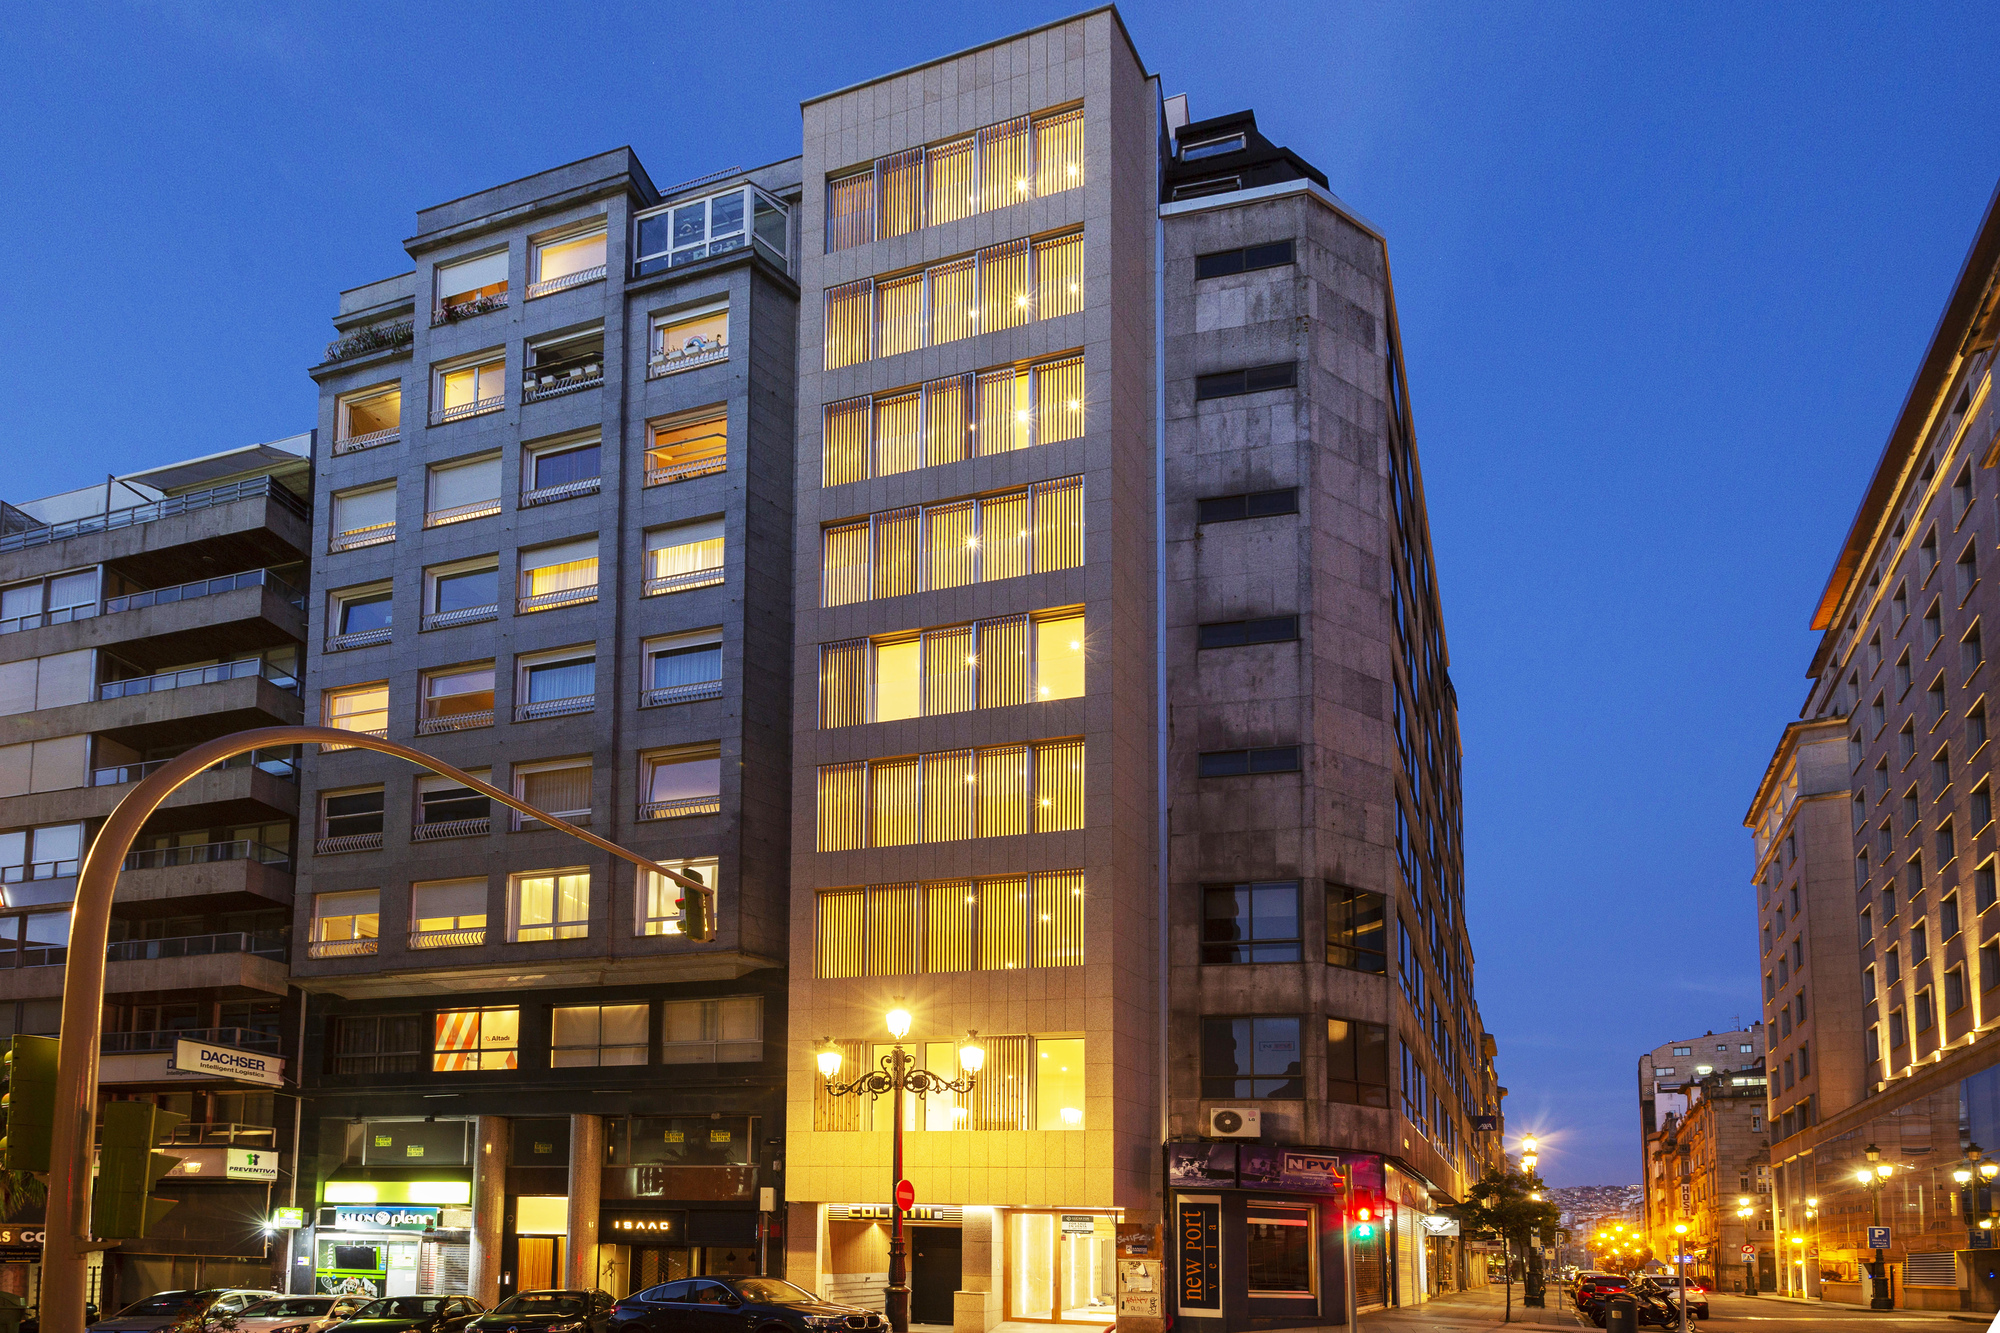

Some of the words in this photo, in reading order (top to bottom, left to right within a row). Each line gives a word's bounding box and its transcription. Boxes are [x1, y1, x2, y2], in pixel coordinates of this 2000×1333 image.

[200, 1049, 265, 1071] DACHSER
[200, 1062, 234, 1074] Intelligent
[235, 1068, 265, 1078] Logistics
[229, 1166, 276, 1174] PREVENTIVA
[614, 1221, 669, 1230] ISAAC
[1874, 1229, 1885, 1238] P
[1186, 1258, 1202, 1301] new
